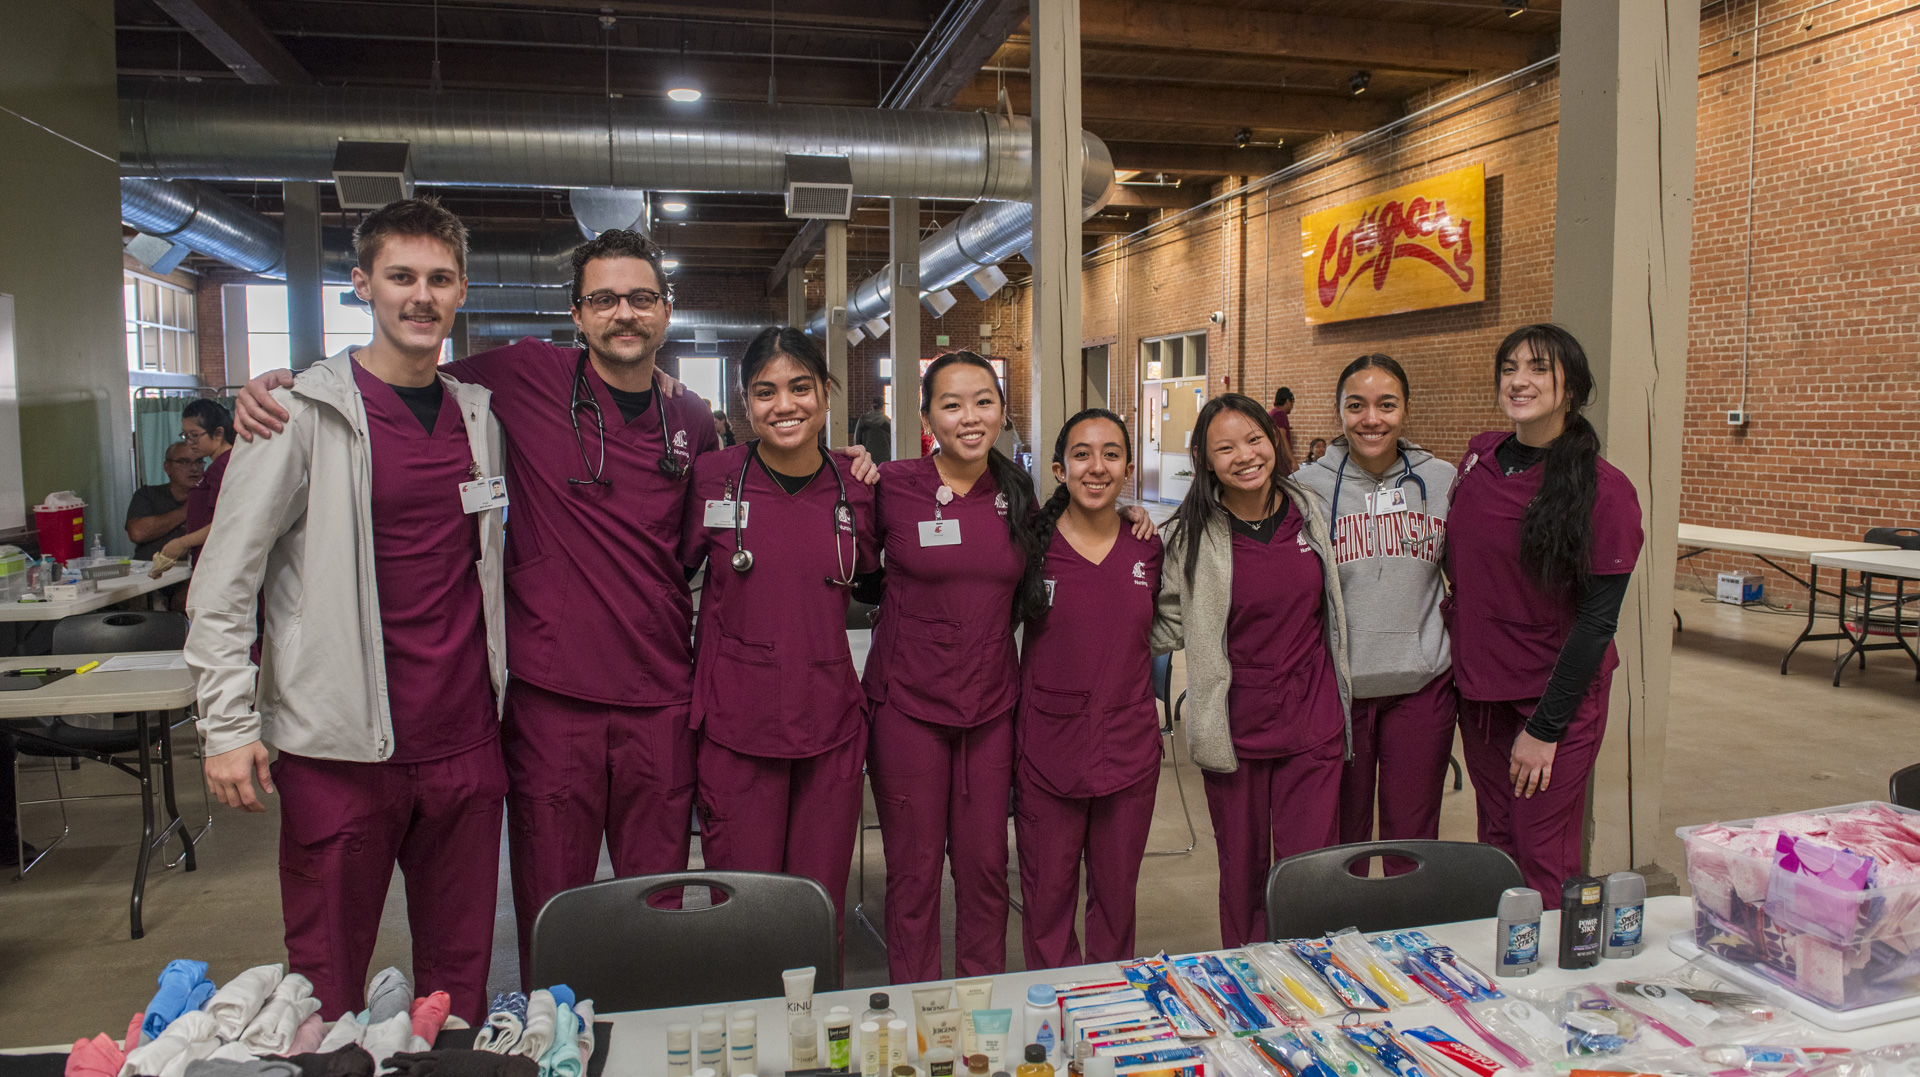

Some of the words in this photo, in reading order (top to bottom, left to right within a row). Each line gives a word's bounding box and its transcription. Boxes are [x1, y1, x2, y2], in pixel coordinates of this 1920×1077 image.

[673, 448, 690, 459] Nursing
[1133, 579, 1148, 588] Nursing
[1578, 918, 1598, 928] POWER
[1619, 911, 1641, 925] SPEED
[1621, 919, 1639, 932] STICK
[1514, 928, 1536, 943] SPEED
[1516, 936, 1535, 950] STICK
[932, 1026, 956, 1035] JERGENS
[1448, 1042, 1502, 1070] Colgate
